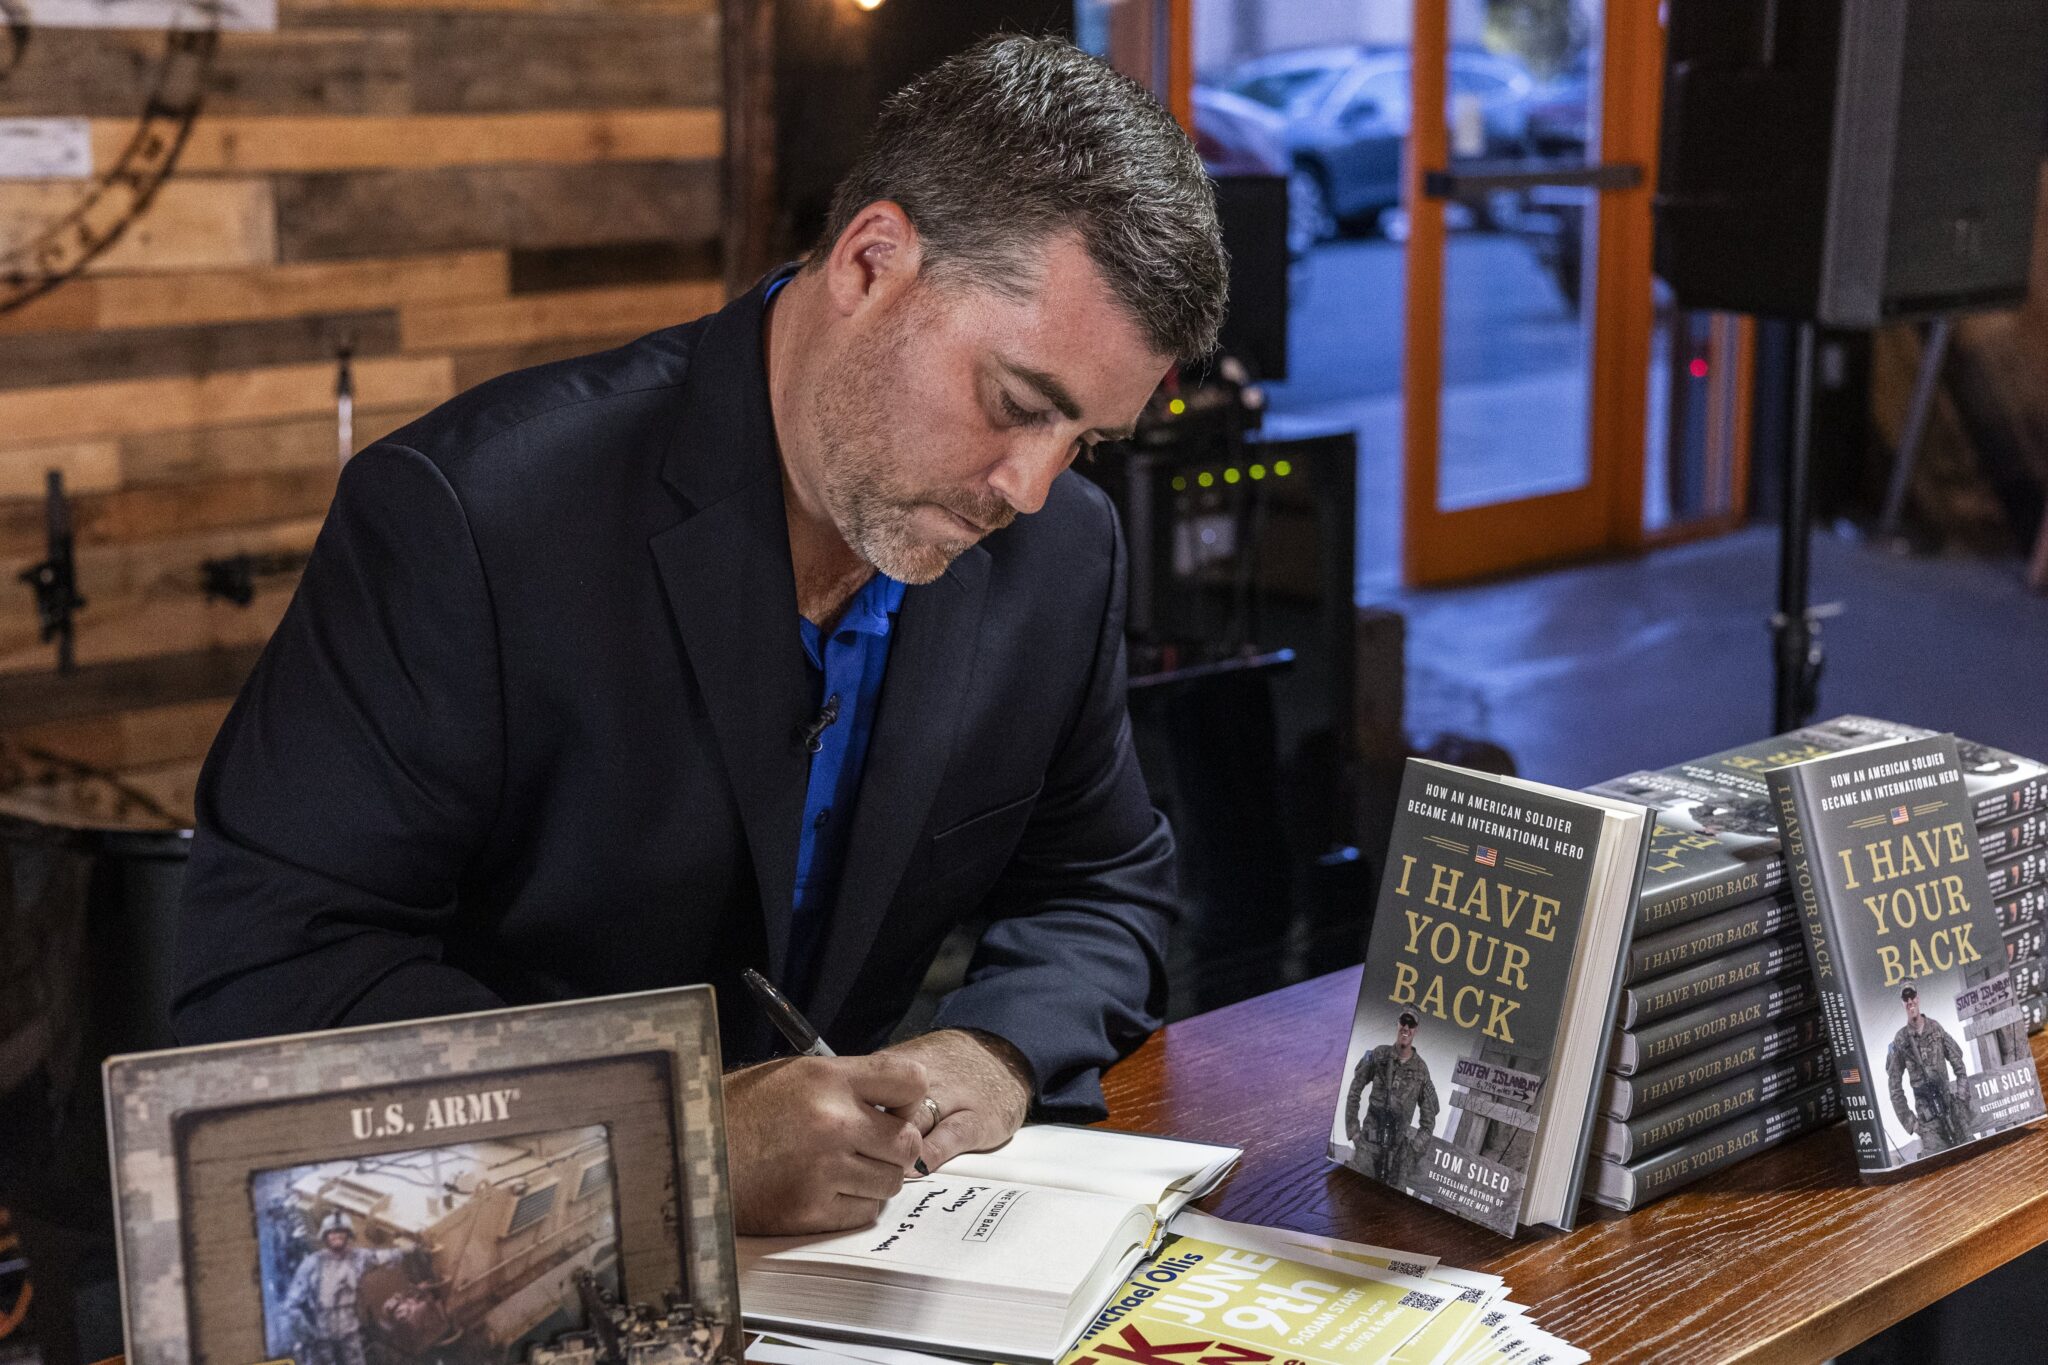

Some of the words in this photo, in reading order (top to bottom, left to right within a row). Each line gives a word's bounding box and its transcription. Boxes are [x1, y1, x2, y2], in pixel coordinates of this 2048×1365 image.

[1778, 785, 1791, 794] I
[1821, 792, 1858, 811] BECAME
[1860, 789, 1873, 803] AN
[1874, 774, 1938, 799] INTERNATIONAL
[1938, 769, 1959, 784] HERO
[1830, 772, 1851, 788] HOW
[1853, 768, 1866, 783] AN
[1868, 760, 1910, 780] AMERICAN
[1911, 752, 1945, 770] SOLDIER
[1407, 800, 1448, 822] BECAME
[1450, 811, 1465, 827] AN
[1467, 816, 1550, 851] INTERNATIONAL
[1554, 840, 1584, 860] HERO
[1425, 783, 1449, 800] HOW
[1450, 790, 1465, 805] AN
[1467, 795, 1522, 821] AMERICAN
[1525, 810, 1572, 835] SOLDIER
[1780, 799, 1805, 856] HAVE
[1838, 848, 1860, 890] I
[1865, 822, 1970, 883] HAVE
[1395, 854, 1417, 897] I
[1424, 863, 1561, 942] HAVE
[1645, 907, 1650, 922] I
[1653, 895, 1688, 920] HAVE
[1691, 886, 1724, 908] YOUR
[1727, 873, 1759, 897] BACK
[1796, 859, 1818, 919] YOUR
[1863, 875, 1971, 936] YOUR
[1404, 910, 1531, 991] YOUR
[1644, 956, 1650, 971] I
[1652, 944, 1688, 968] HAVE
[1690, 933, 1724, 955] YOUR
[1727, 920, 1759, 943] BACK
[1809, 922, 1833, 979] BACK
[1877, 923, 1982, 987] BACK
[1388, 961, 1521, 1044] BACK
[1645, 998, 1652, 1013] I
[1654, 985, 1690, 1010] HAVE
[1692, 973, 1726, 996] YOUR
[1728, 961, 1761, 985] BACK
[1648, 1044, 1654, 1058] I
[1657, 1030, 1691, 1055] HAVE
[1694, 1017, 1727, 1040] YOUR
[1730, 1004, 1761, 1028] BACK
[1457, 1060, 1490, 1081] STATEN
[1642, 1088, 1648, 1103] I
[1651, 1075, 1686, 1100] HAVE
[1688, 1061, 1721, 1084] YOUR
[1724, 1046, 1757, 1071] BACK
[1974, 1078, 1999, 1099] TOM
[2001, 1067, 2032, 1091] SILEO
[351, 1103, 415, 1140] U.S.
[1641, 1132, 1648, 1147] I
[1650, 1119, 1686, 1144] HAVE
[1687, 1104, 1721, 1128] YOUR
[1723, 1088, 1756, 1113] BACK
[1846, 1095, 1867, 1107] TOM
[1847, 1109, 1875, 1121] SILEO
[1434, 1148, 1463, 1174] TOM
[1467, 1162, 1510, 1193] SILEO
[1645, 1175, 1651, 1190] I
[1653, 1161, 1689, 1186] HAVE
[1691, 1145, 1725, 1169] YOUR
[1727, 1129, 1760, 1155] BACK
[987, 1201, 1008, 1217] YOUR
[1428, 1170, 1468, 1193] BESTSELLING
[1468, 1187, 1494, 1204] AUTHOR
[1495, 1199, 1505, 1208] OF
[1438, 1186, 1458, 1201] THREE
[1458, 1195, 1475, 1208] WISE
[1475, 1203, 1490, 1214] MEN
[973, 1218, 994, 1237] BACK
[1145, 1252, 1204, 1284] Ollis
[1151, 1248, 1280, 1325] JUNE
[1222, 1278, 1341, 1336] 9th
[1327, 1287, 1367, 1314] START
